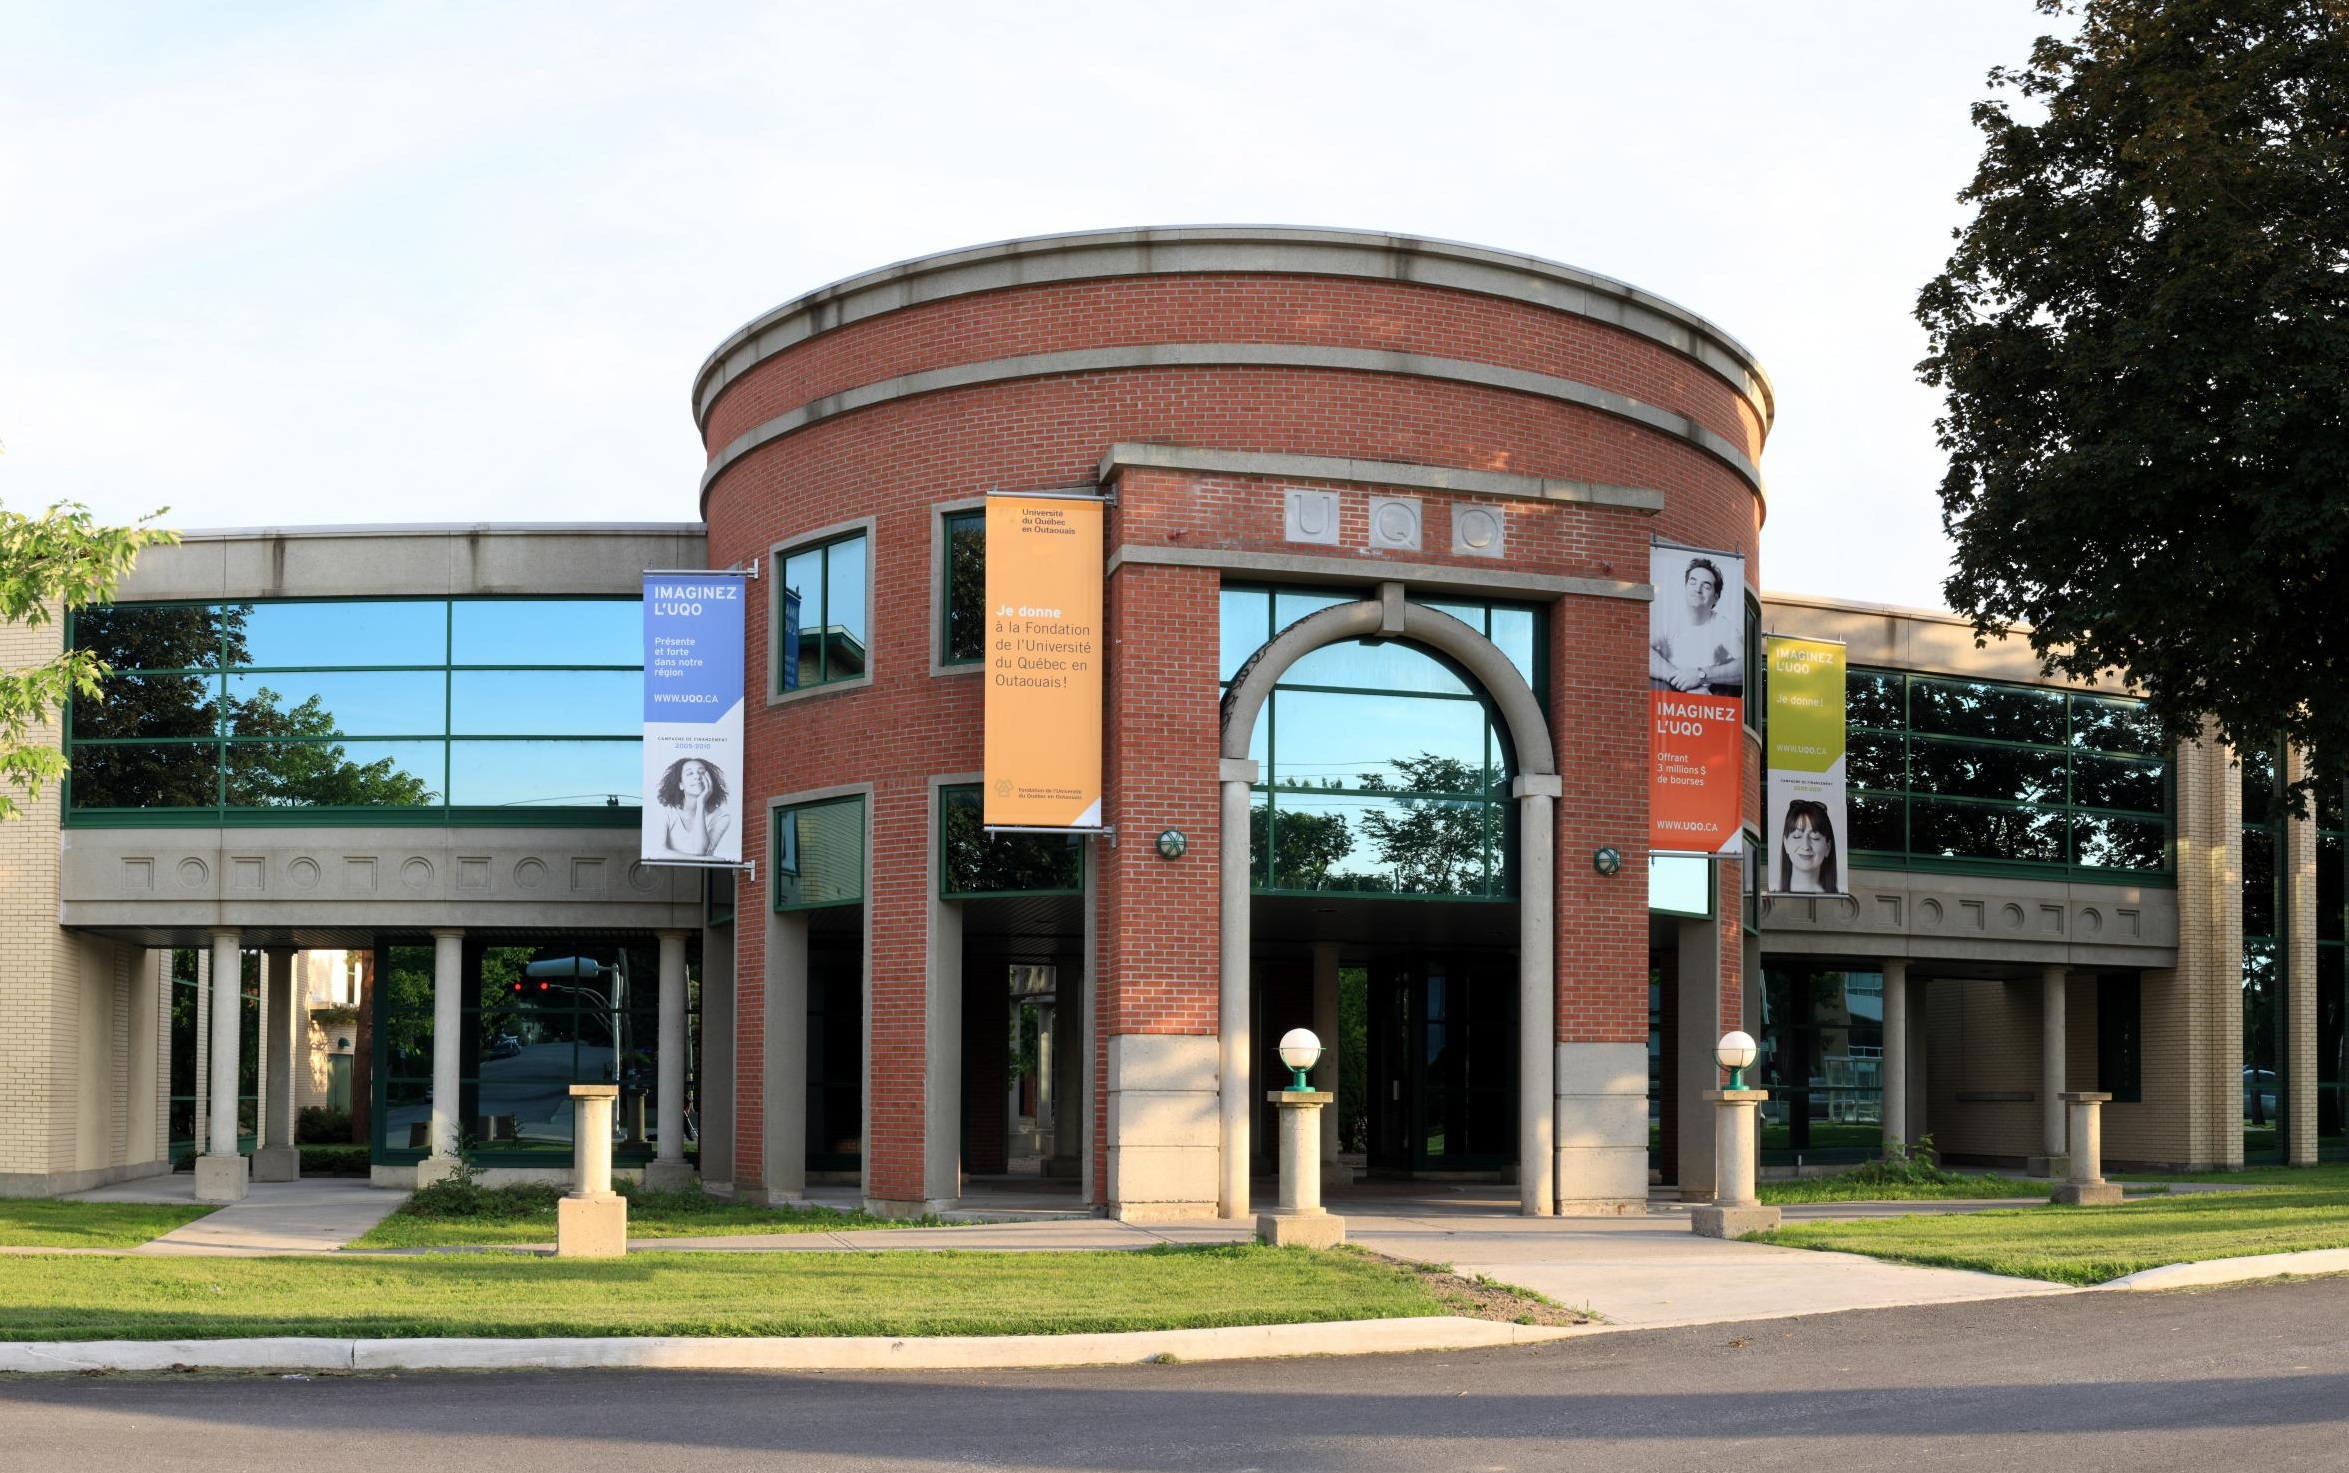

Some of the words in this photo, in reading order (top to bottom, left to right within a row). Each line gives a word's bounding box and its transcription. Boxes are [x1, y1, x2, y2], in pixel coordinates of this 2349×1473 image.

[1022, 508, 1064, 517] Université
[1022, 517, 1033, 525] du
[1034, 517, 1066, 526] Québec
[1034, 526, 1076, 535] Outaouais
[654, 586, 737, 600] IMAGINEZ
[654, 602, 703, 616] L'UQO
[997, 605, 1014, 616] Je
[1019, 606, 1061, 618] donne
[995, 620, 1003, 633] à
[1009, 621, 1020, 633] la
[1026, 621, 1090, 636] Fondation
[654, 637, 696, 646] Présente
[995, 639, 1012, 651] de
[654, 647, 664, 656] et
[666, 647, 689, 656] forte
[1776, 648, 1833, 664] IMAGINEZ
[654, 658, 676, 666] dans
[679, 659, 703, 667] notre
[995, 656, 1012, 669] du
[1017, 657, 1067, 671] Québec
[1071, 662, 1088, 672] en
[1776, 661, 1810, 675] L'UQO
[654, 668, 683, 678] région
[654, 694, 719, 703] WWW.UQO.CA
[1777, 694, 1788, 704] Je
[1657, 702, 1736, 722] IMAGINEZ
[1657, 720, 1703, 737] L'UQO
[1776, 744, 1827, 755] WWW.UQO.CA
[1657, 752, 1689, 764] Offrant
[1657, 763, 1663, 772] 3
[1666, 764, 1699, 775] millions
[1701, 765, 1707, 776] $
[1657, 774, 1668, 784] de
[1670, 775, 1704, 786] bourses
[1656, 820, 1719, 832] WWW.UQO.CA
